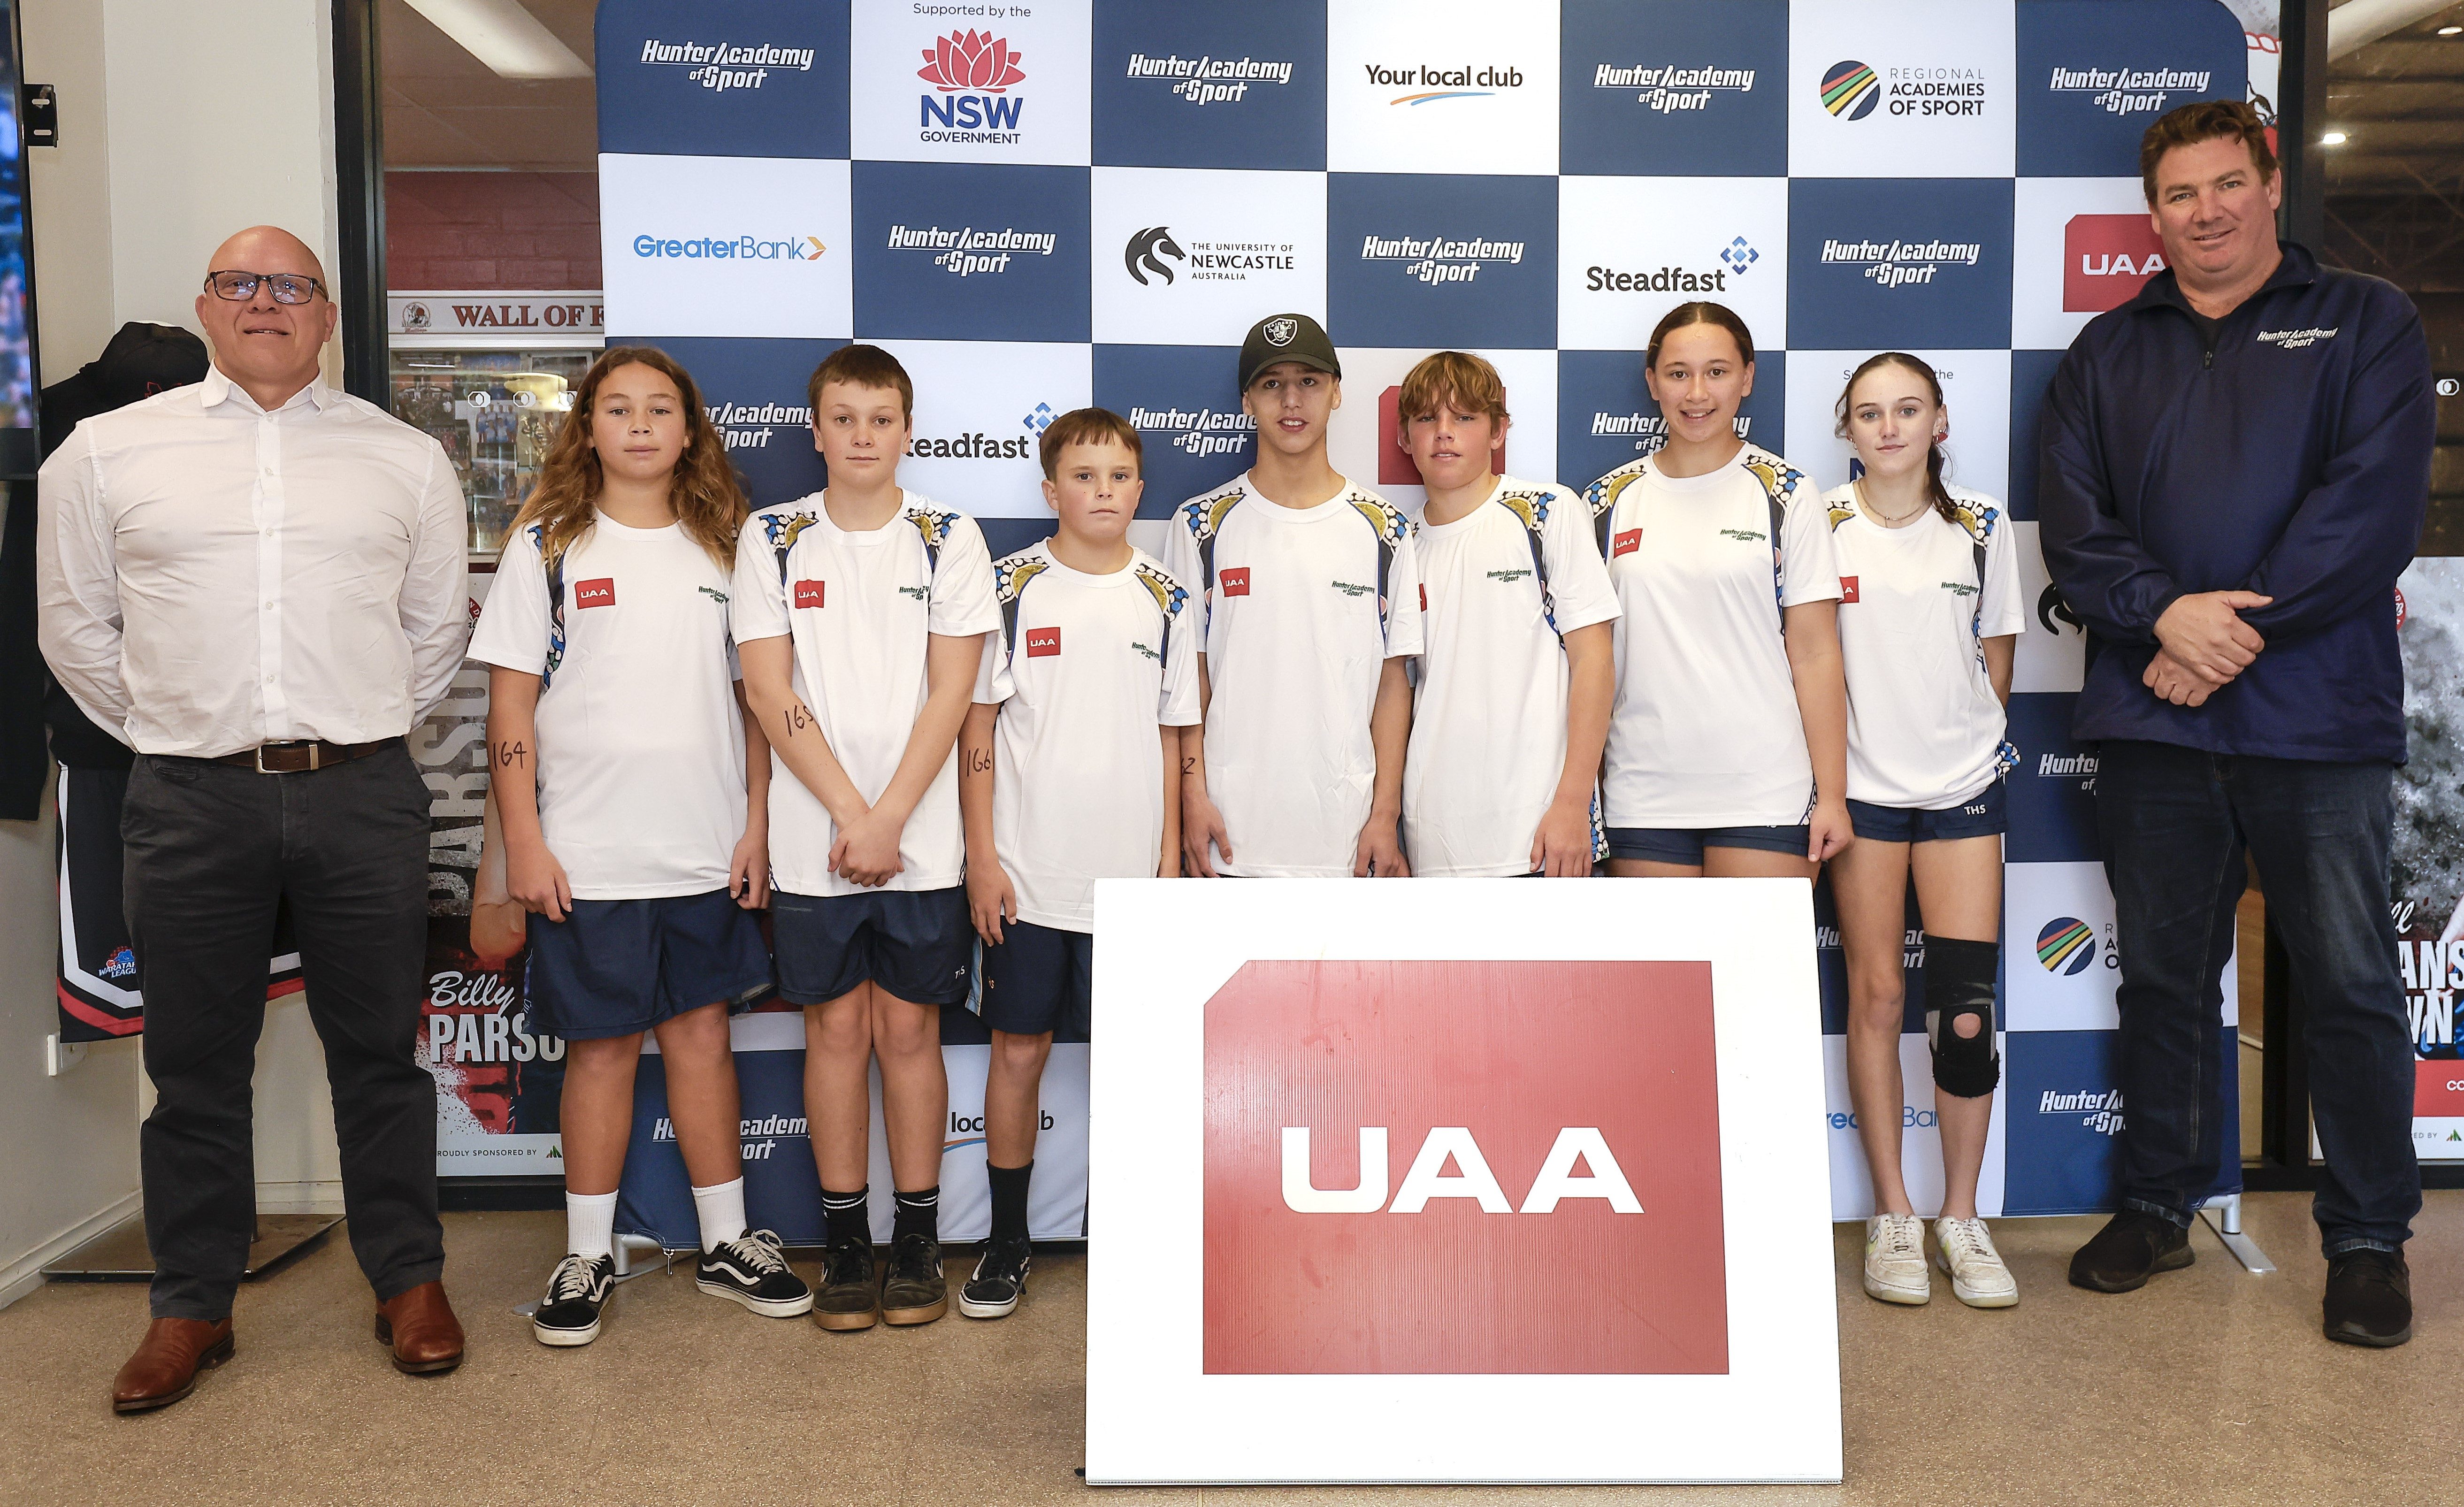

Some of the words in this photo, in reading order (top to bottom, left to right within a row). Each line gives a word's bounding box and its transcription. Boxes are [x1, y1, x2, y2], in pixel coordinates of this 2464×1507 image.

[913, 3, 984, 18] Supported
[988, 5, 1006, 18] by
[1010, 6, 1031, 17] the
[641, 39, 714, 64] Hunter
[1127, 54, 1197, 77] Hunter
[1365, 64, 1416, 86] Your
[1421, 65, 1471, 86] local
[1477, 66, 1523, 87] club
[1594, 63, 1663, 86] Hunter
[1890, 68, 1984, 80] REGIONAL
[689, 69, 704, 81] of
[702, 67, 767, 92] Sport
[2051, 67, 2119, 89] Hunter
[1173, 83, 1187, 95] of
[1186, 80, 1247, 106] Sport
[1890, 83, 1984, 97] ACADEMIES
[921, 95, 1023, 130] NSW
[1638, 91, 1652, 103] of
[1650, 89, 1712, 115] Sport
[1890, 100, 1917, 116] OF
[1921, 100, 1984, 116] SPORT
[2094, 95, 2108, 107] of
[2106, 91, 2167, 116] Sport
[920, 131, 1020, 145] GOVERNMENT
[634, 235, 805, 260] GreaterBank
[888, 225, 960, 249] Hunter
[1216, 244, 1277, 252] UNIVERSITY
[1361, 236, 1431, 259] Hunter
[1821, 239, 1890, 261] Hunter
[934, 255, 949, 267] of
[948, 252, 1010, 277] Sport
[1192, 255, 1293, 270] NEWCASTLE
[1407, 263, 1422, 275] of
[1419, 261, 1480, 287] Sport
[2082, 254, 2166, 275] UAA
[1586, 266, 1726, 292] Steadfast
[1865, 266, 1879, 278] of
[1876, 264, 1936, 288] Sport
[452, 305, 538, 327] WALL
[543, 305, 584, 327] OF
[2257, 330, 2293, 341] Hunter
[2283, 337, 2315, 349] Sport
[1129, 407, 1198, 429] Hunter
[1194, 408, 1257, 430] Acade
[1591, 412, 1659, 434] Hunter
[907, 433, 1028, 459] teadfast
[1173, 435, 1188, 446] of
[1186, 432, 1247, 458] Sport
[1615, 537, 1636, 549] UAA
[1224, 577, 1245, 586] UAA
[581, 589, 609, 599] UAA
[1030, 638, 1056, 647] UAA
[1132, 642, 1147, 650] Hunte
[784, 705, 814, 737] 165
[493, 741, 527, 771] 164
[967, 748, 991, 777] 166
[1964, 804, 1986, 816] THS
[111, 967, 137, 978] LEAGU
[429, 971, 515, 1018] Billy
[2039, 1089, 2107, 1111] Hunter
[2083, 1114, 2098, 1126] of
[1281, 1126, 1645, 1214] UAA
